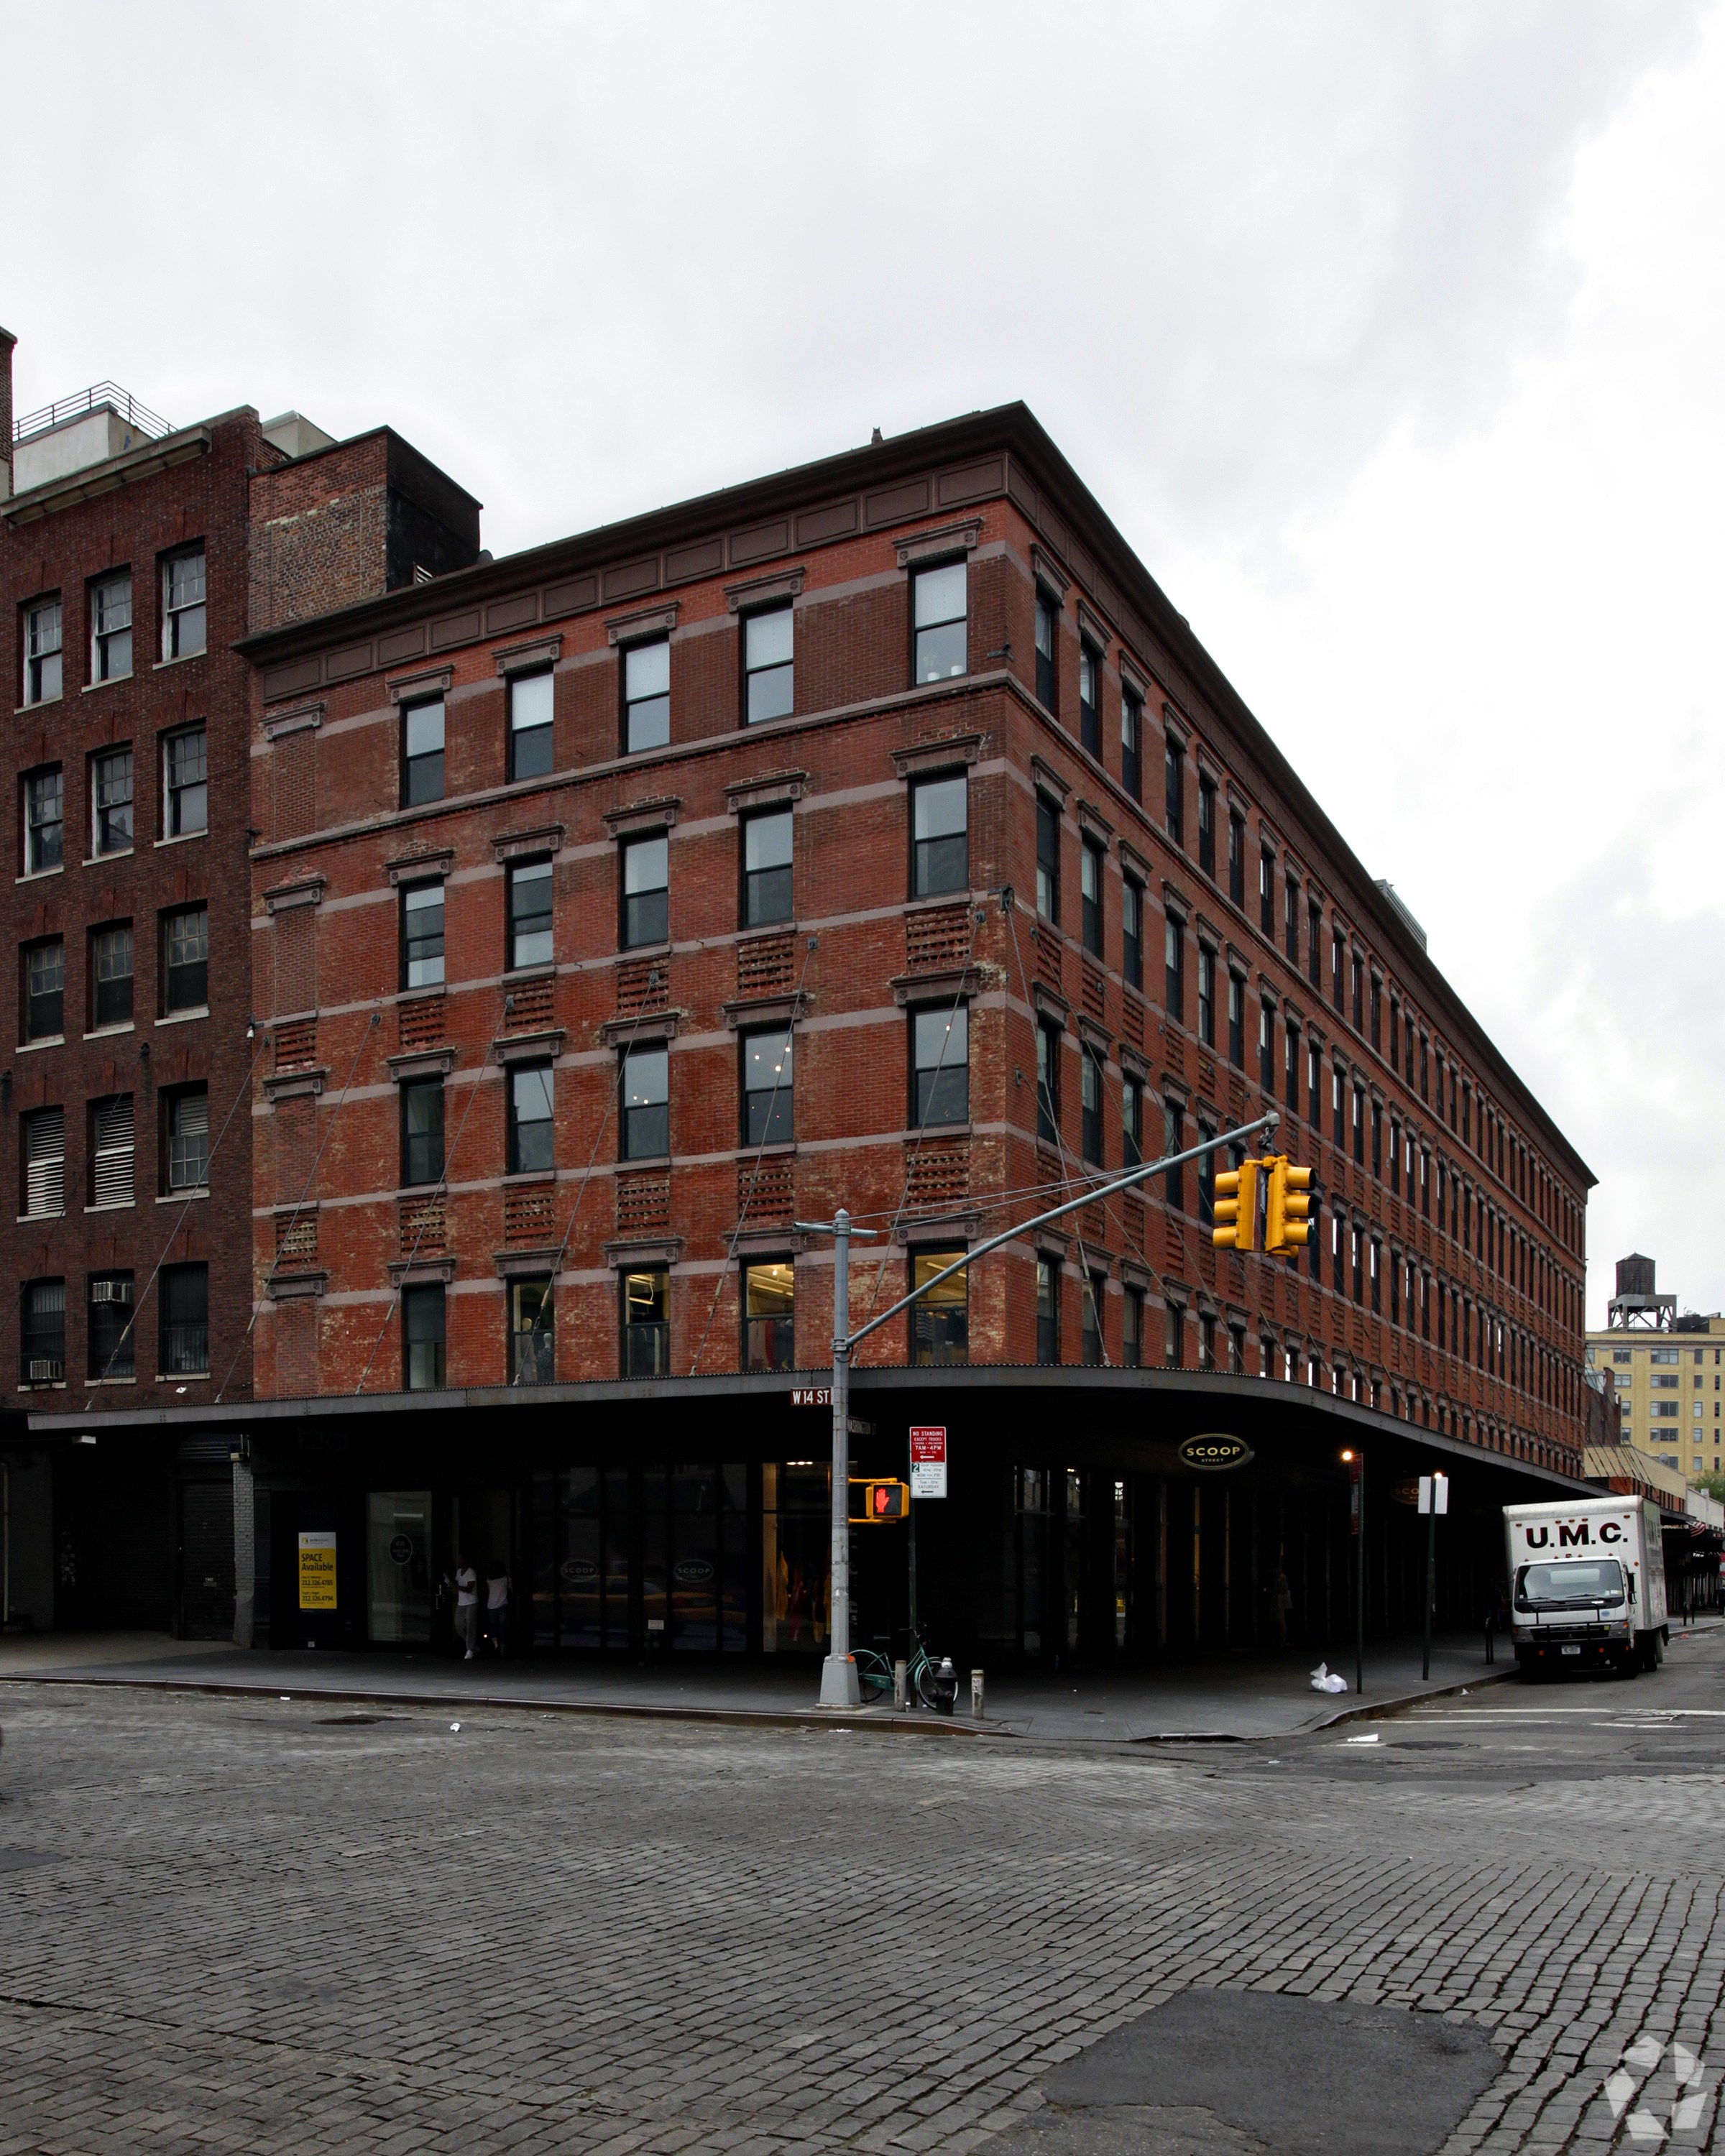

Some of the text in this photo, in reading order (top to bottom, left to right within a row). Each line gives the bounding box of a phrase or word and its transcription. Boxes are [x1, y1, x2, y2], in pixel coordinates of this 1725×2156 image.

[793, 1390, 829, 1404] W 14 ST
[1187, 1447, 1241, 1456] SCOOP
[913, 1463, 919, 1473] 2
[1526, 1522, 1628, 1549] U.M.C.
[301, 1553, 323, 1562] SPACE
[301, 1562, 334, 1571] Available
